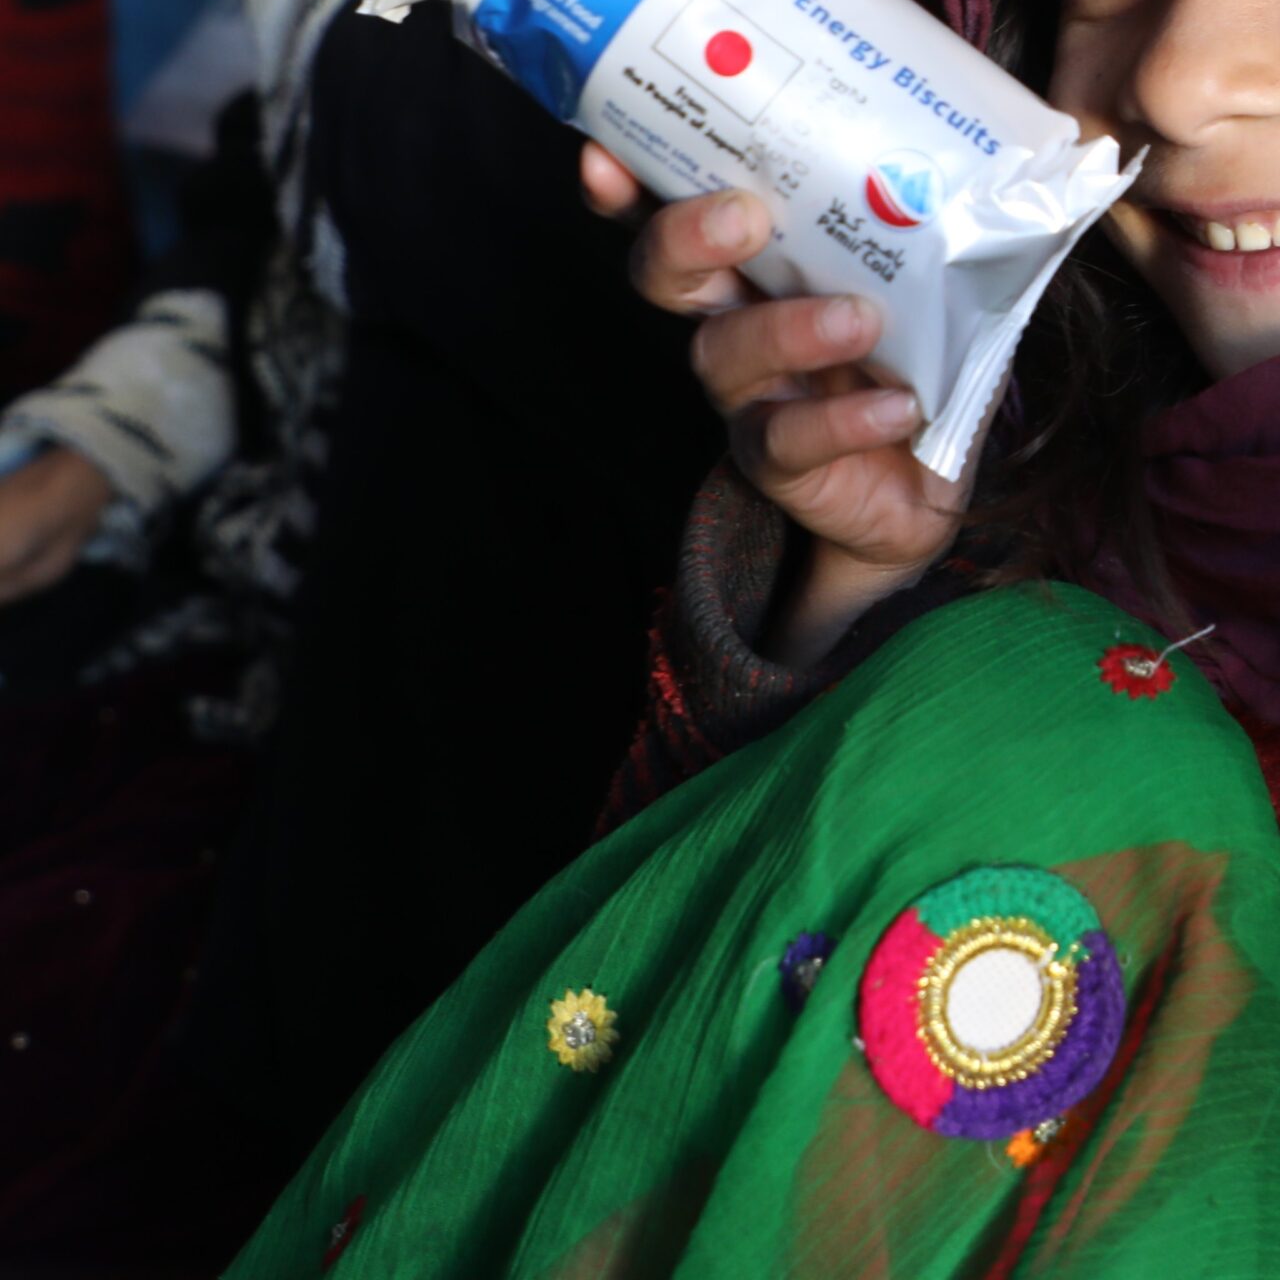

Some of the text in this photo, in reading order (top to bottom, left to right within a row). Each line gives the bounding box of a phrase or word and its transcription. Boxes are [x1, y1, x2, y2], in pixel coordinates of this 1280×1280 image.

[622, 66, 643, 87] the
[644, 82, 688, 119] People
[688, 117, 706, 131] of
[675, 85, 708, 116] From
[892, 66, 1001, 156] Biscuits
[816, 214, 861, 256] Pamir
[861, 250, 896, 283] Cola
